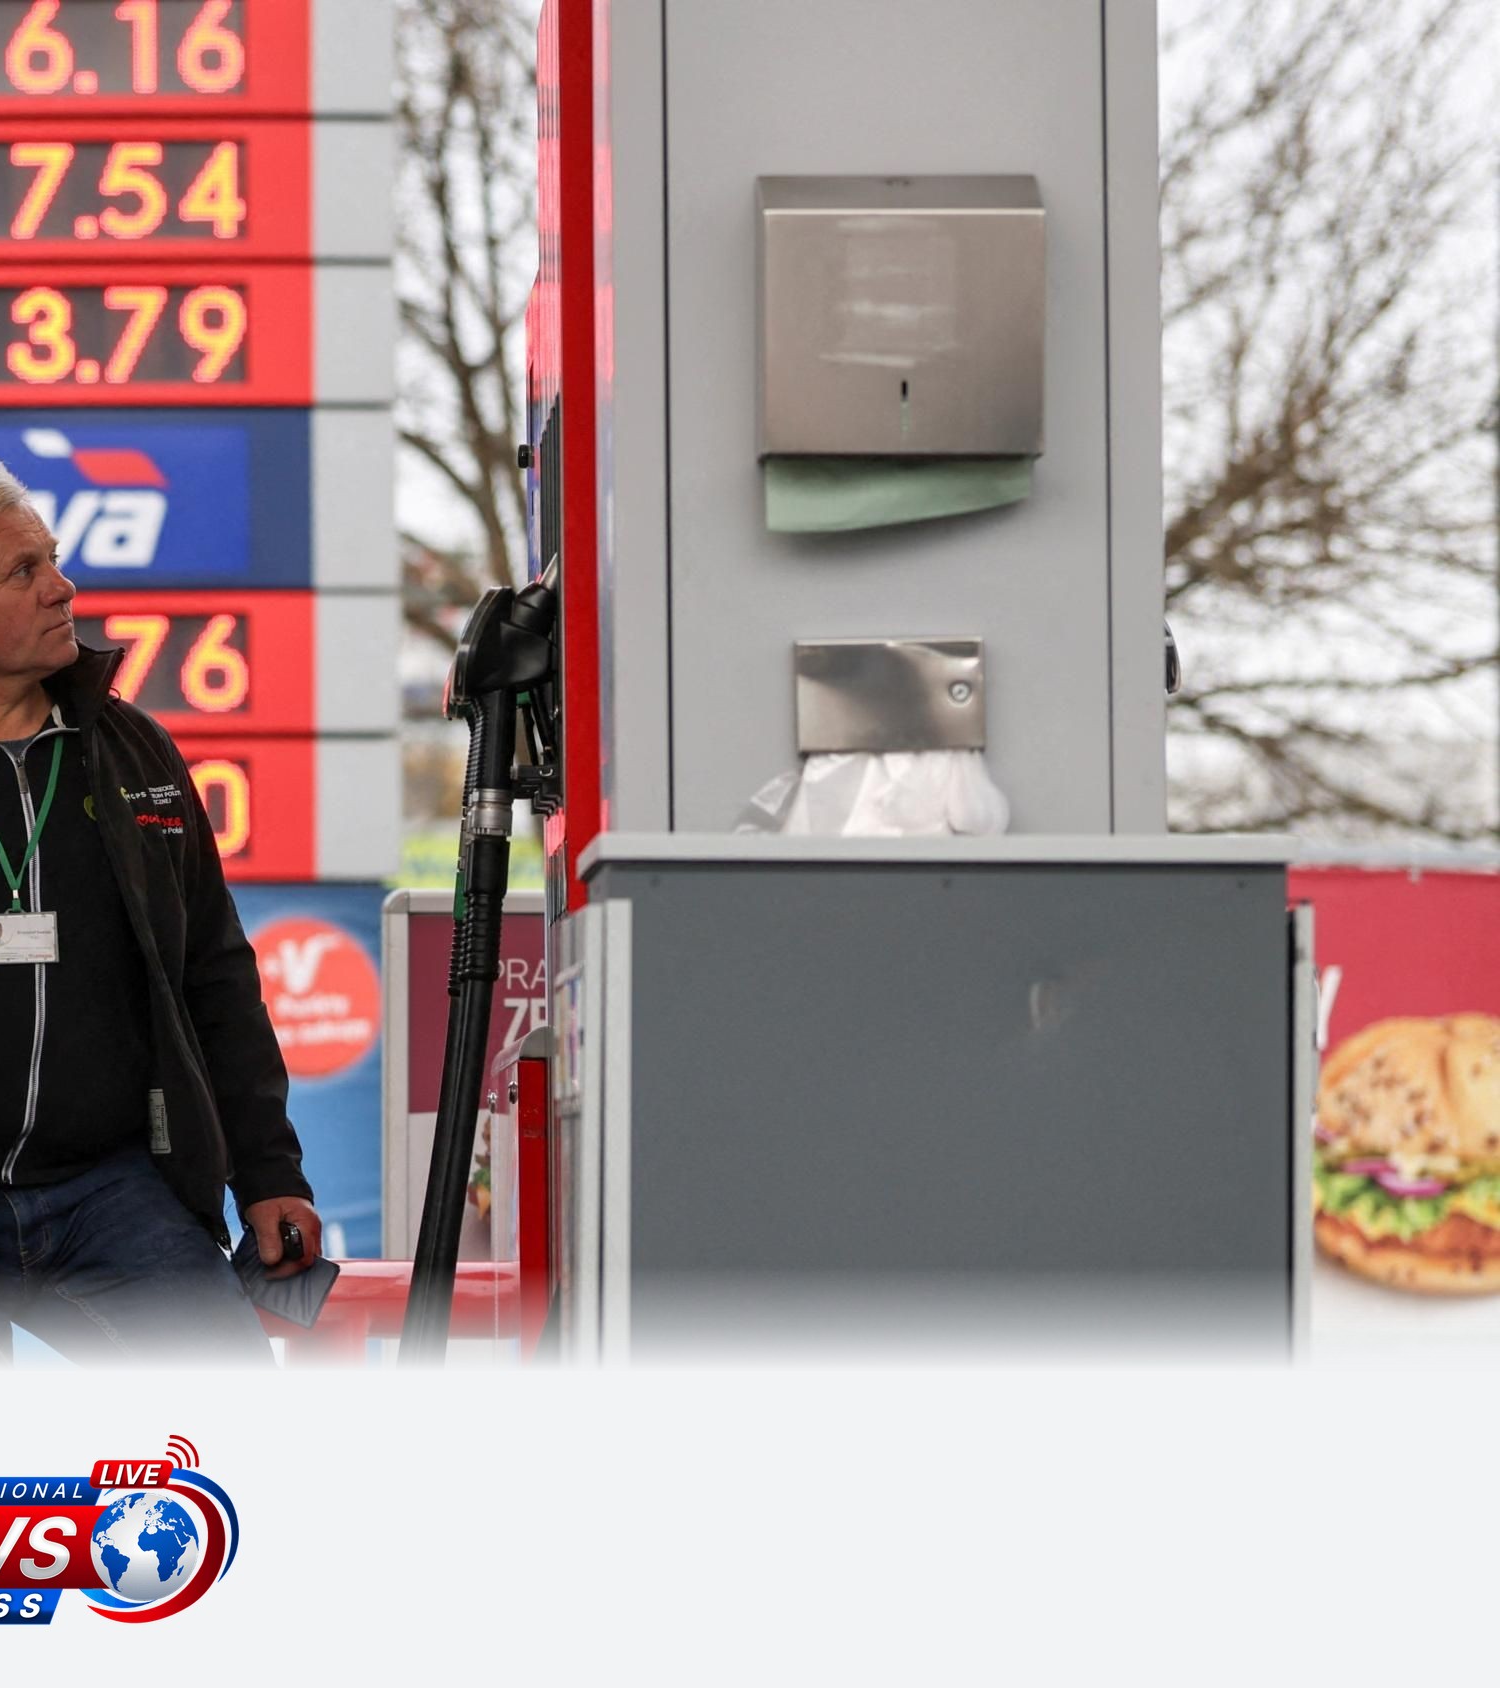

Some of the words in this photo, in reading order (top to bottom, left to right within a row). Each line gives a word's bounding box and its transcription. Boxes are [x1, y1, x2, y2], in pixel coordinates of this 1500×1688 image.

[5, 0, 245, 94] 6.16
[10, 140, 246, 239] 7.54
[7, 285, 247, 384] 3.79
